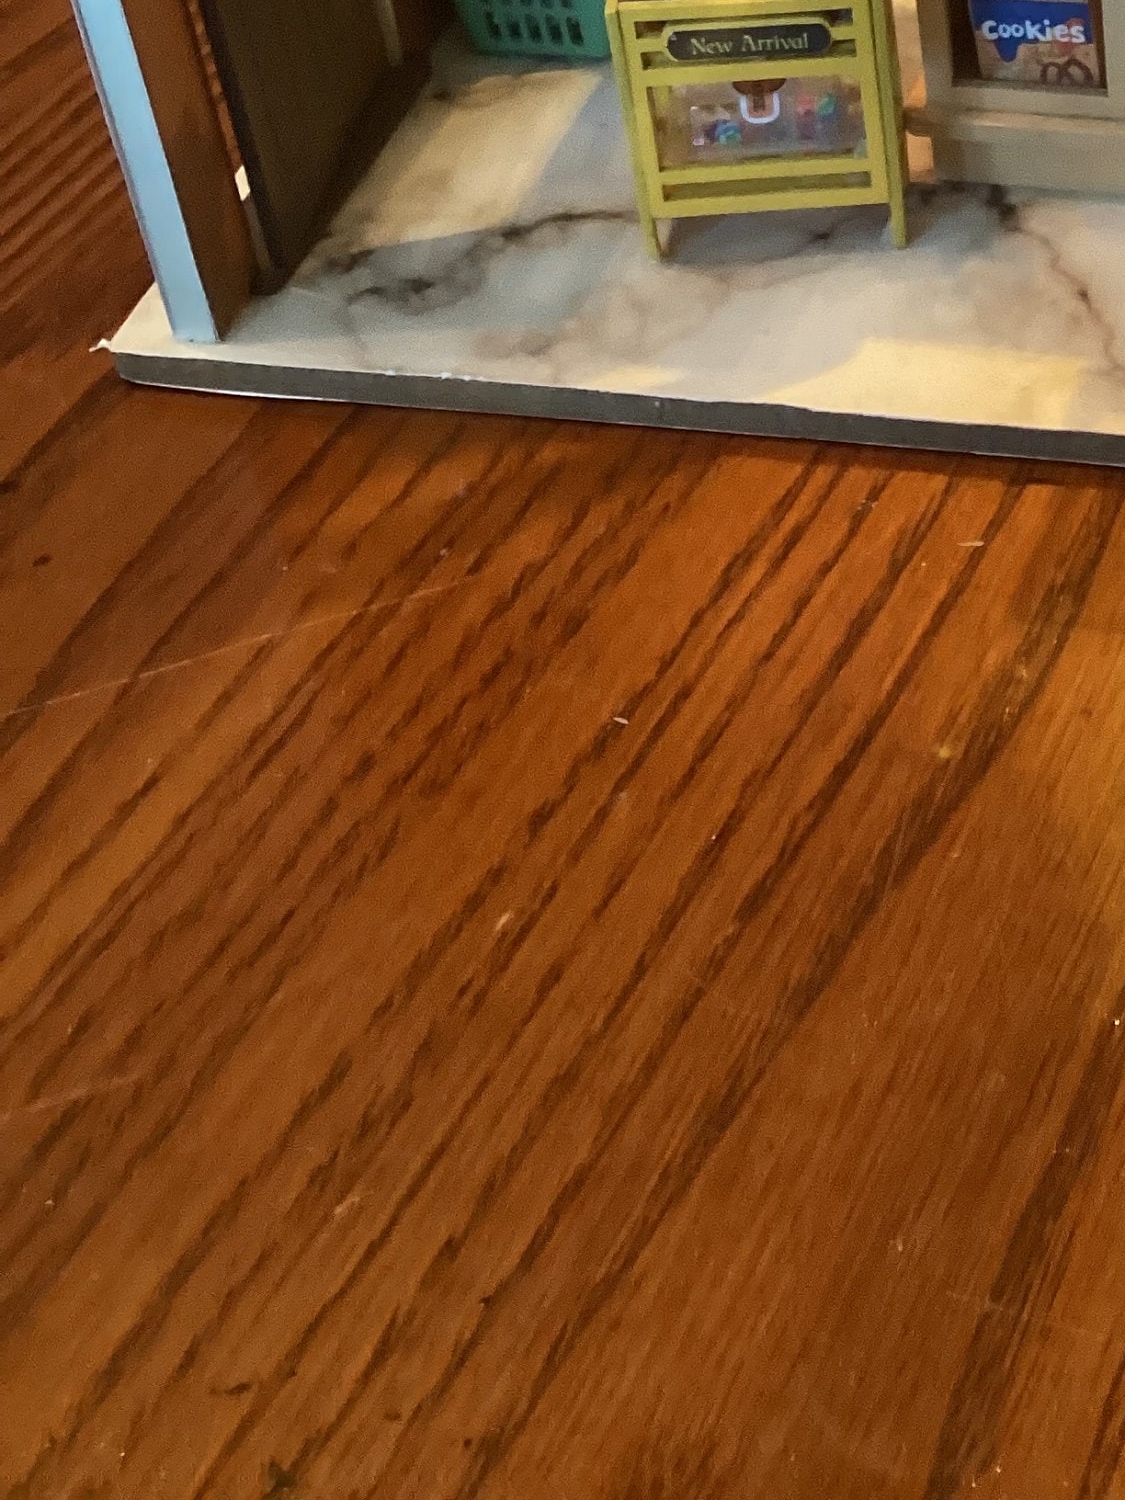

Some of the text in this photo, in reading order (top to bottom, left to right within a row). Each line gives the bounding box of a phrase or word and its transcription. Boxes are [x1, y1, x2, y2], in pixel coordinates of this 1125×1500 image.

[980, 18, 1087, 44] Cookies
[690, 32, 810, 56] New Arrival
